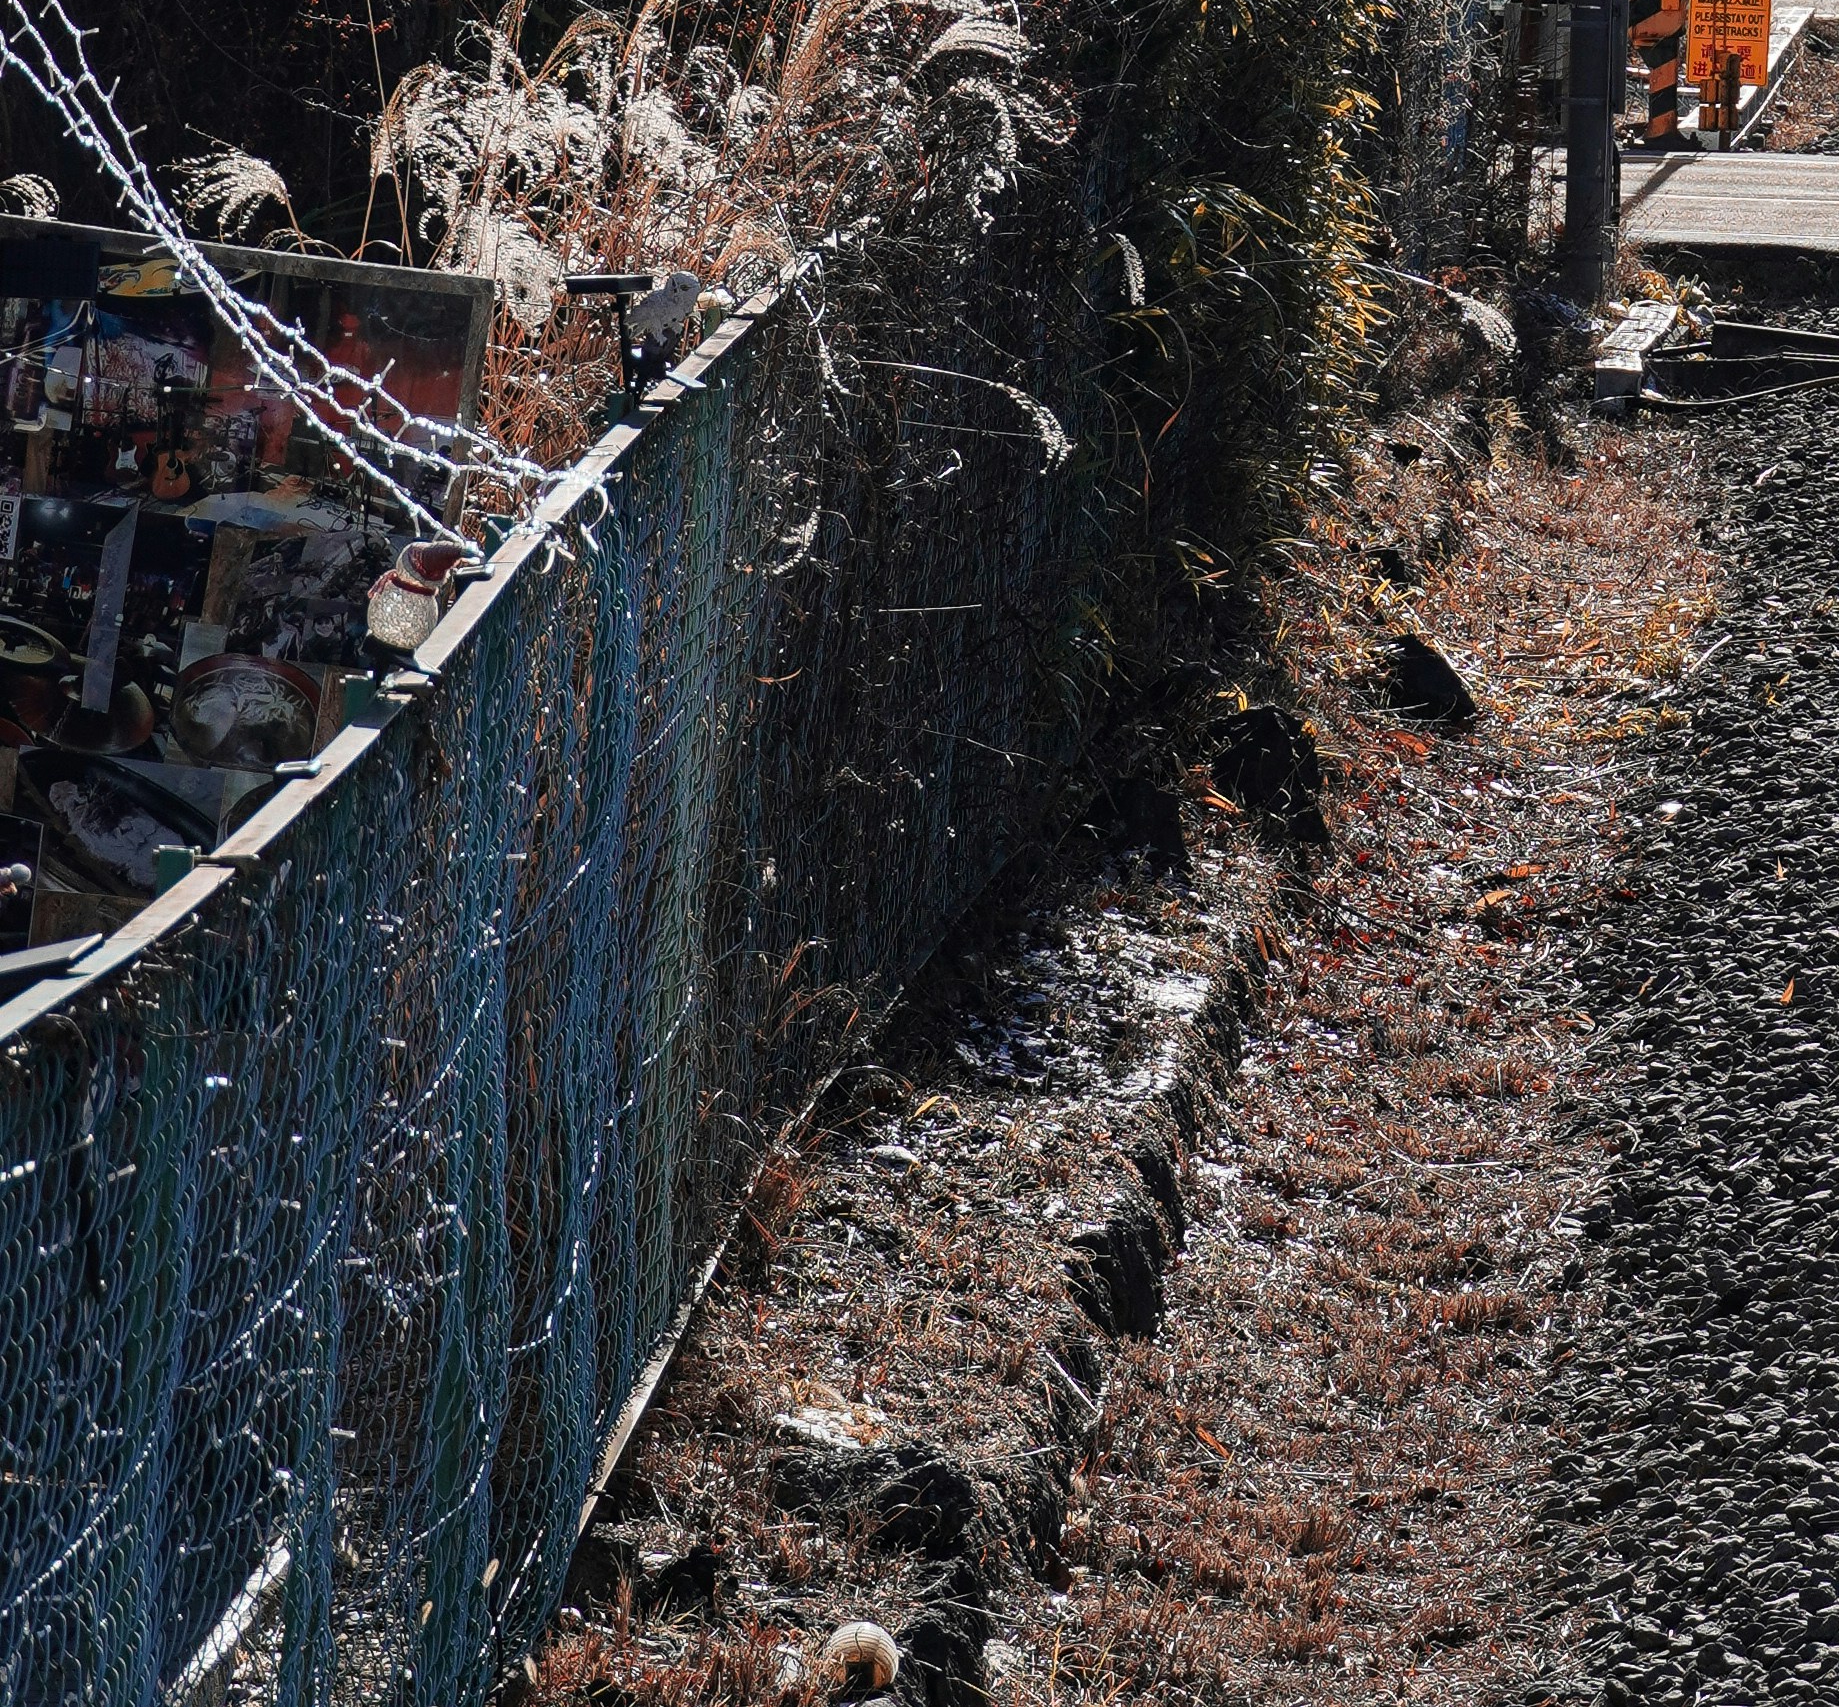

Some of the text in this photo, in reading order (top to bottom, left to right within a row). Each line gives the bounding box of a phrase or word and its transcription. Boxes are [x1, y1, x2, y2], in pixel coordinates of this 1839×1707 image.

[1695, 12, 1765, 25] PLEASE STAY OUT
[1694, 25, 1763, 38] OF THE TRACKS!
